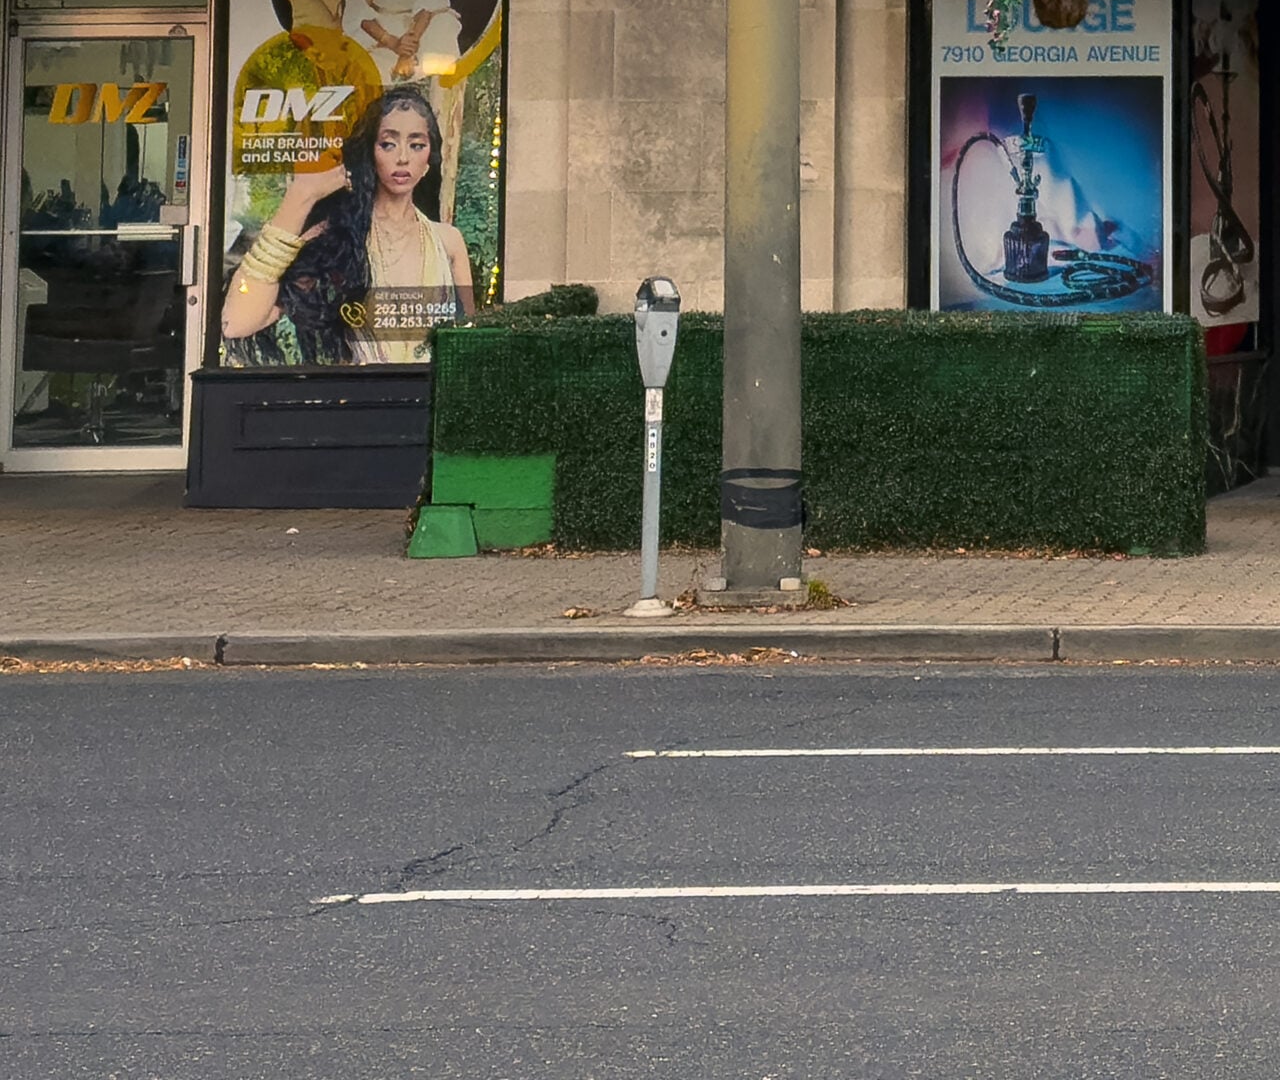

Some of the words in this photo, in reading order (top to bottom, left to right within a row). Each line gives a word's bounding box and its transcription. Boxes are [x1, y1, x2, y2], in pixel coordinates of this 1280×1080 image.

[941, 46, 984, 63] 7910
[992, 46, 1078, 62] GEORGIA
[1087, 46, 1161, 62] AVENUE
[48, 82, 168, 124] DMZ
[240, 85, 355, 123] DMZ
[242, 138, 275, 150] HAIR
[277, 136, 344, 150] BRAIDING
[241, 150, 270, 163] and
[273, 150, 319, 163] SALON
